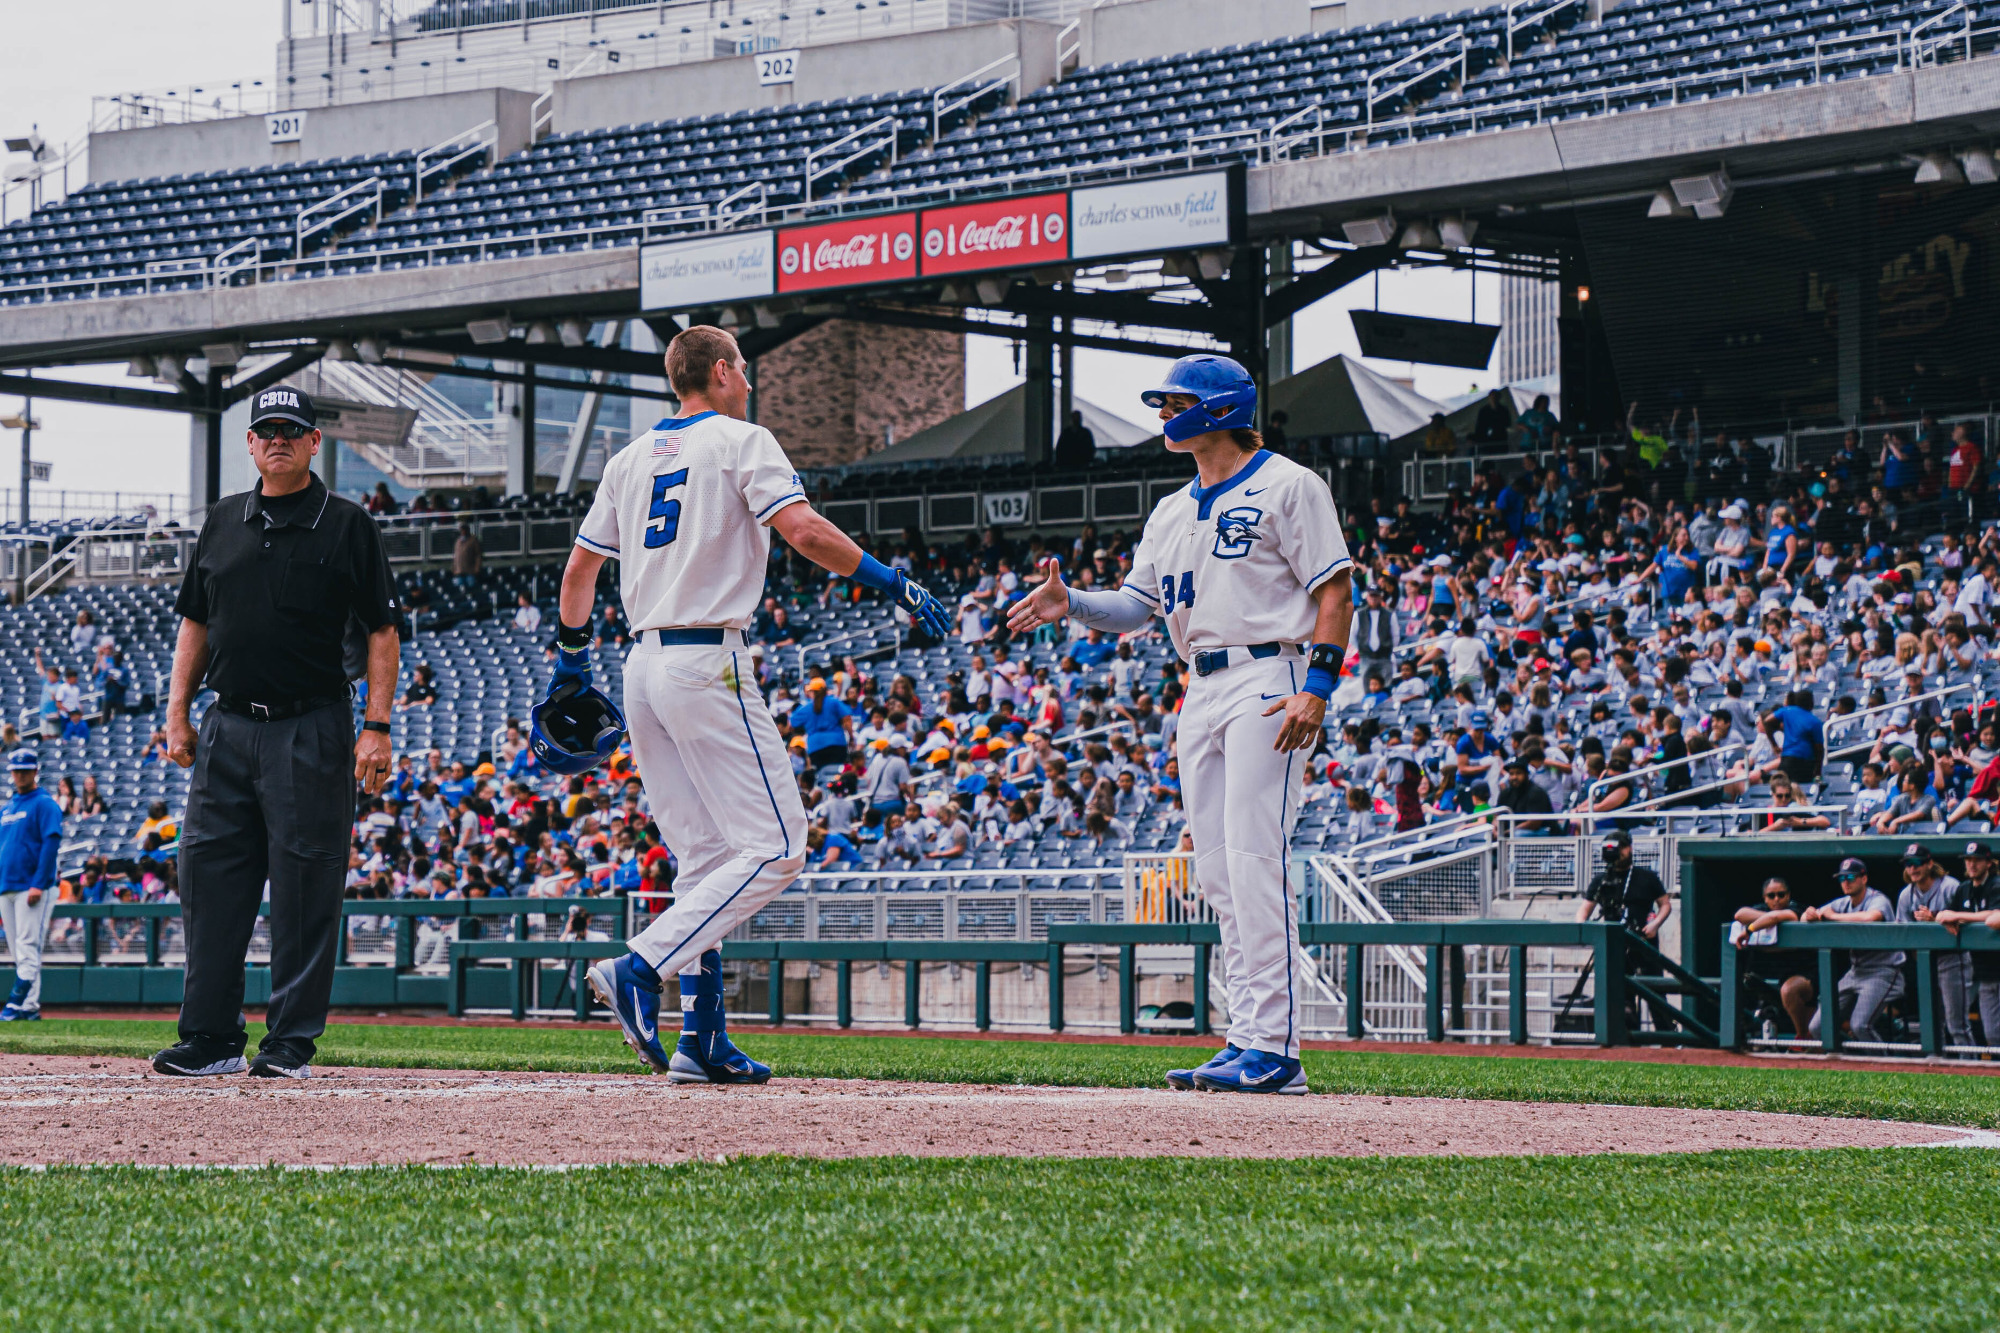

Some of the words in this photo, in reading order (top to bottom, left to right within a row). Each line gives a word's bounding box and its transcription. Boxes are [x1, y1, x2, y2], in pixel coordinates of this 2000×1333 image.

[762, 58, 793, 77] 202
[272, 118, 299, 135] 201
[1078, 203, 1127, 227] charles
[1130, 203, 1182, 221] SCHWAB
[1179, 190, 1217, 223] field
[259, 391, 300, 408] CBUA
[644, 467, 689, 549] 5
[991, 497, 1023, 518] 103
[1162, 571, 1195, 615] 34
